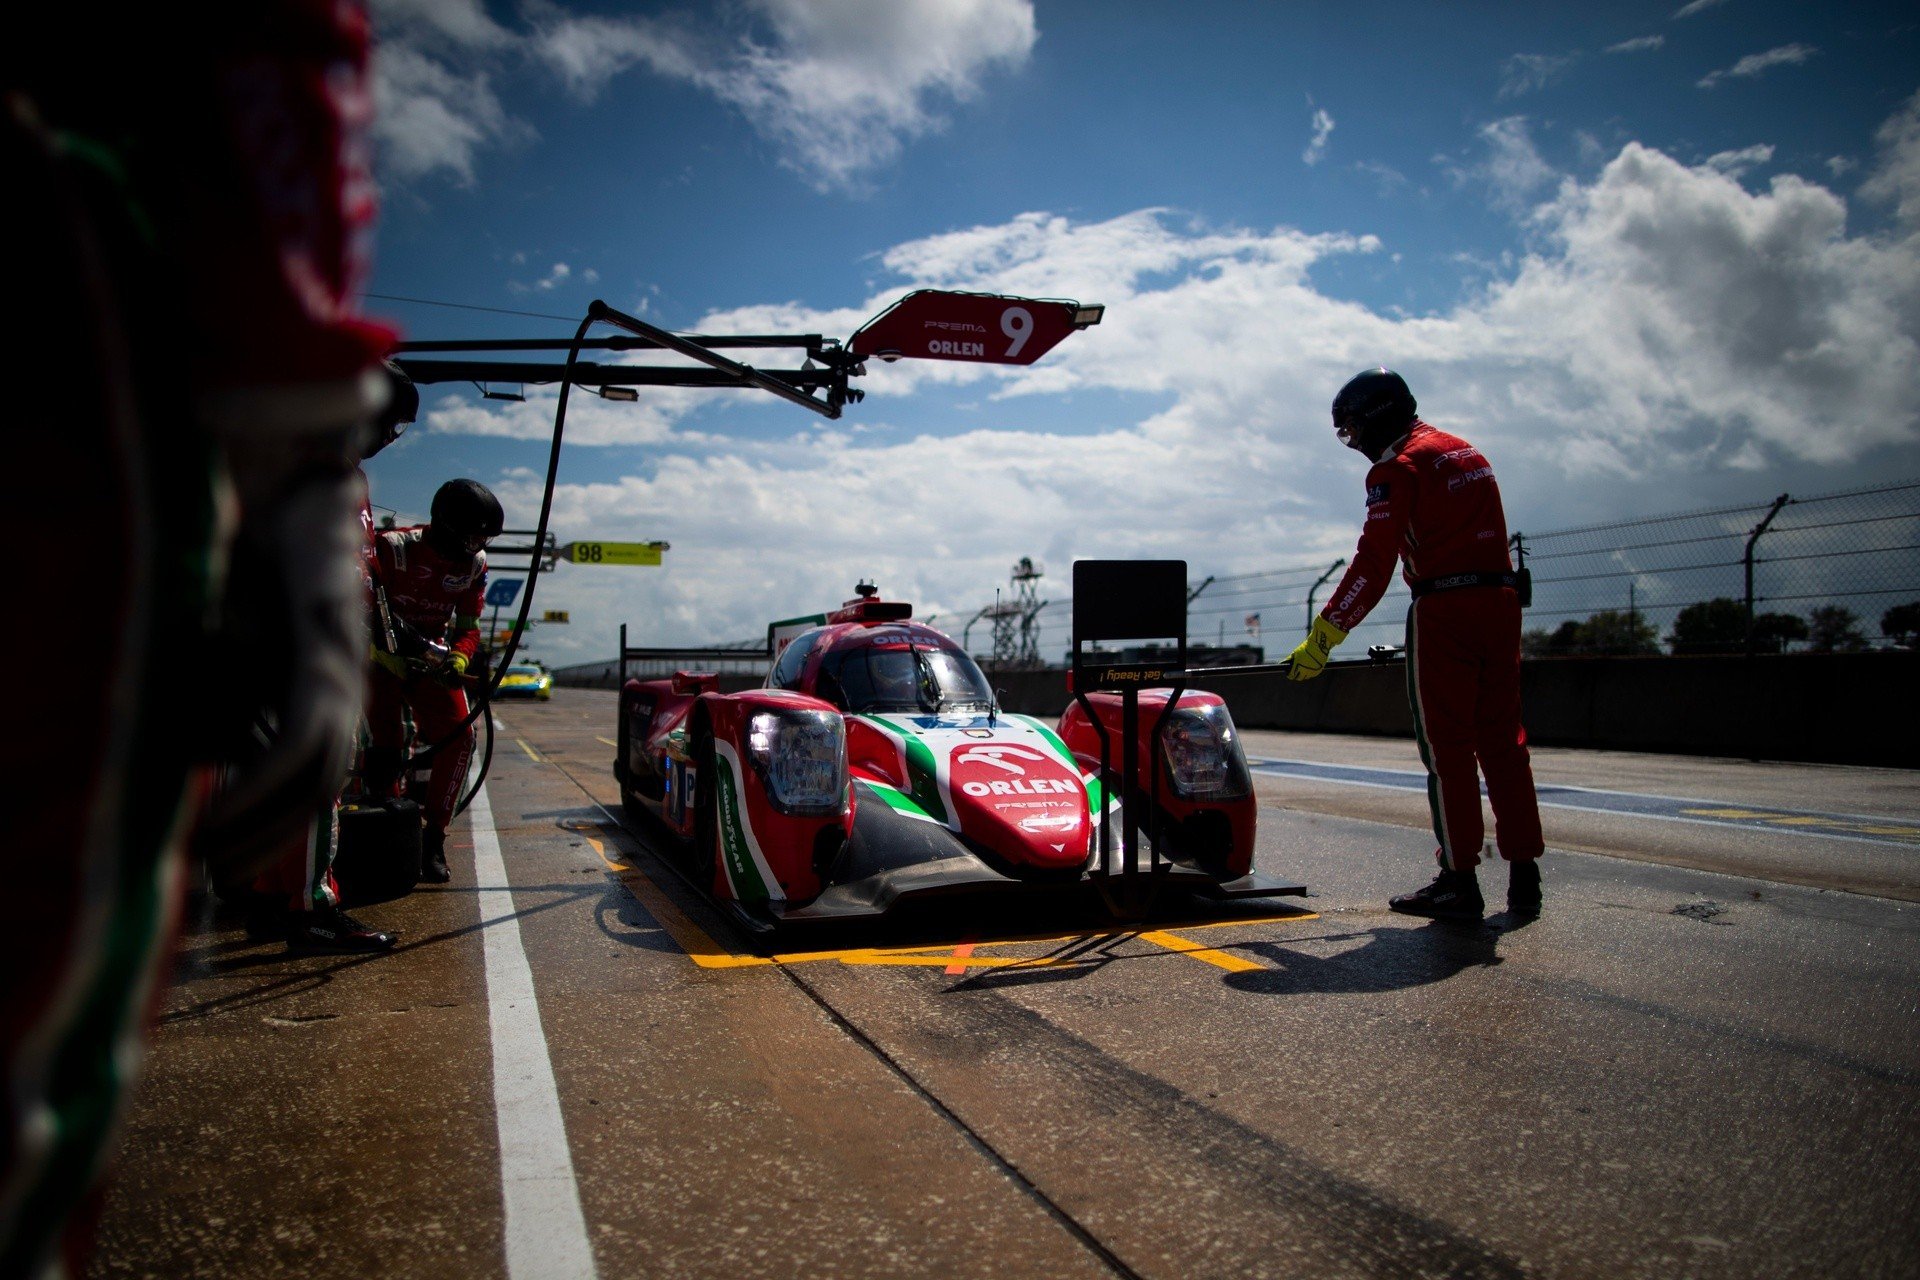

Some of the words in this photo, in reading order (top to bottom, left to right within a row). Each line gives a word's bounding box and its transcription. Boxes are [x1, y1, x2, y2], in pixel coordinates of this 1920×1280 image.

[924, 320, 987, 333] PREMA
[1000, 306, 1035, 357] 9
[928, 339, 984, 356] ORLEN
[578, 544, 602, 562] 98
[1434, 573, 1478, 588] sparco
[1339, 575, 1368, 611] ORLEN
[873, 635, 940, 647] ORLEN
[1106, 669, 1141, 682] Ready
[1143, 670, 1162, 681] Get
[962, 779, 1079, 797] ORLEN
[994, 800, 1075, 810] PREMA
[722, 783, 745, 874] GOODYEAR
